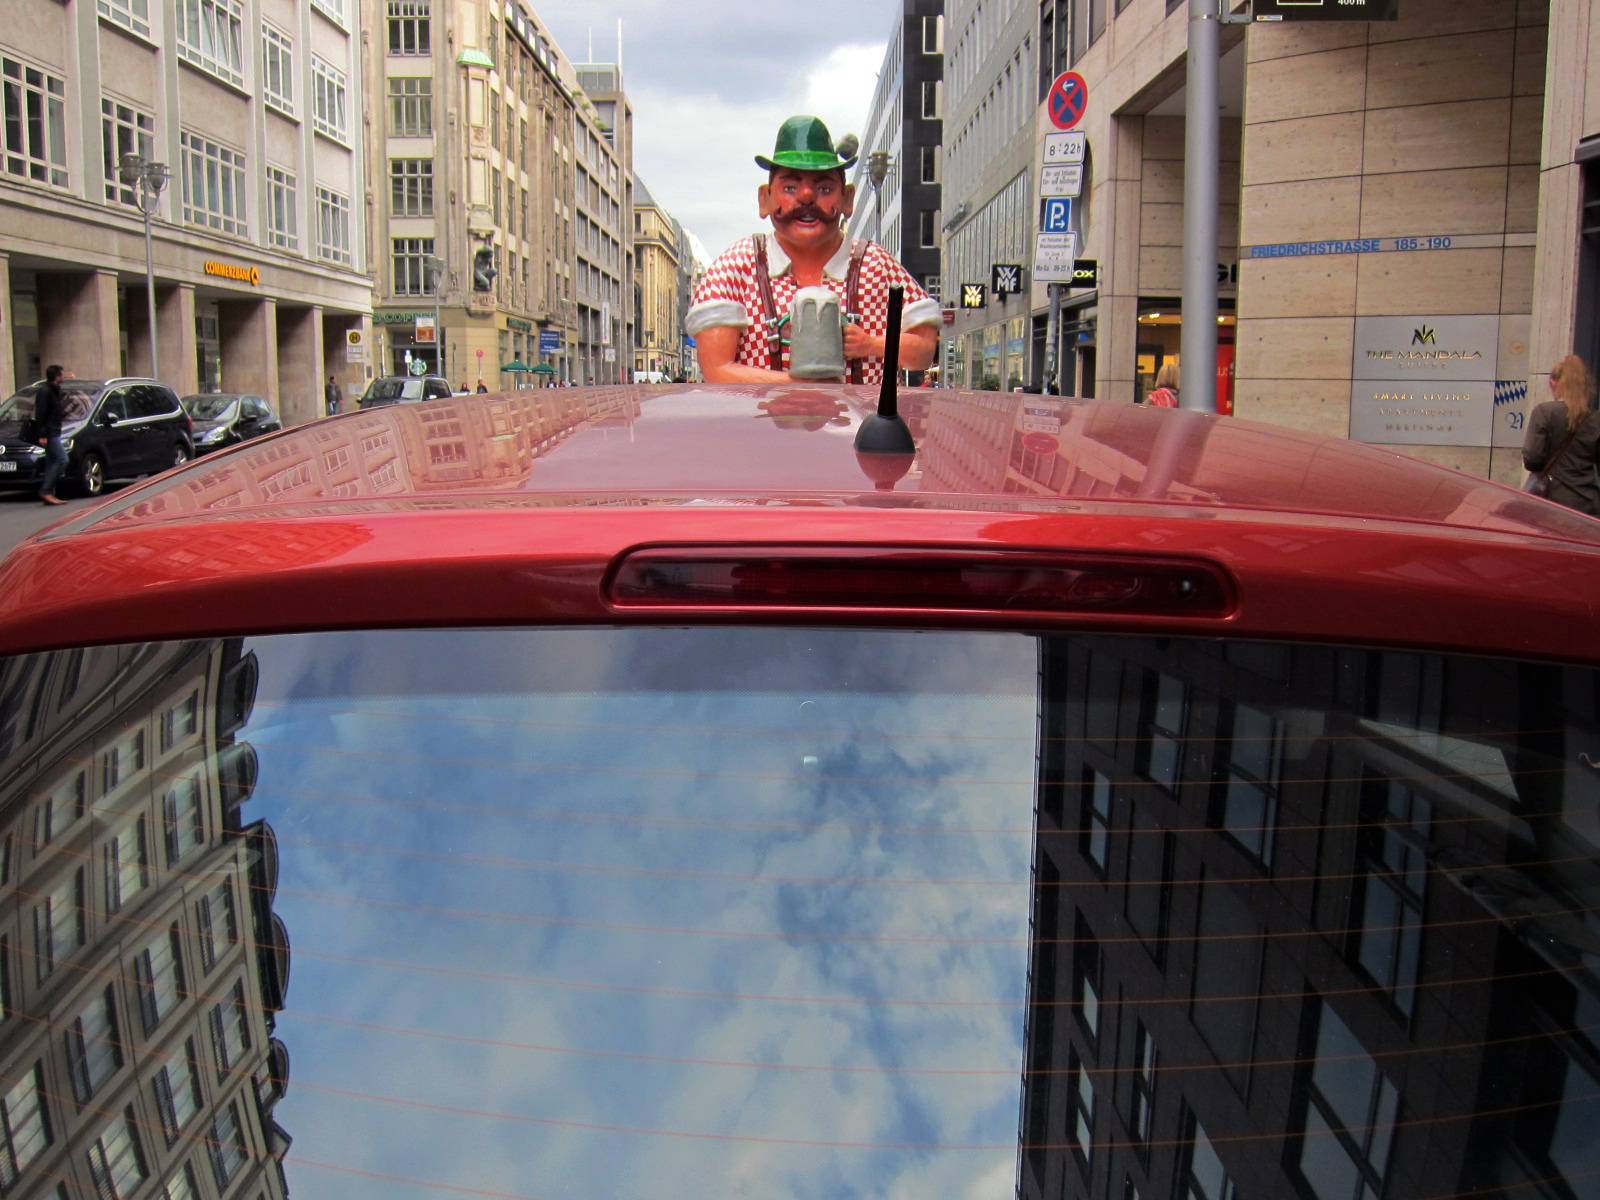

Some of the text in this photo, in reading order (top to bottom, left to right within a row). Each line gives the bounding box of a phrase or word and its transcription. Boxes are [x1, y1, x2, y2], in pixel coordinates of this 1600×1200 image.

[1050, 202, 1065, 229] P
[1251, 240, 1380, 258] FRIEDRICHSTRASSE
[205, 260, 250, 281] COMMERZBANK
[996, 266, 1018, 292] WMF
[964, 285, 982, 307] WMF
[1366, 350, 1482, 359] THE MANDALA
[1423, 393, 1471, 401] LIVING
